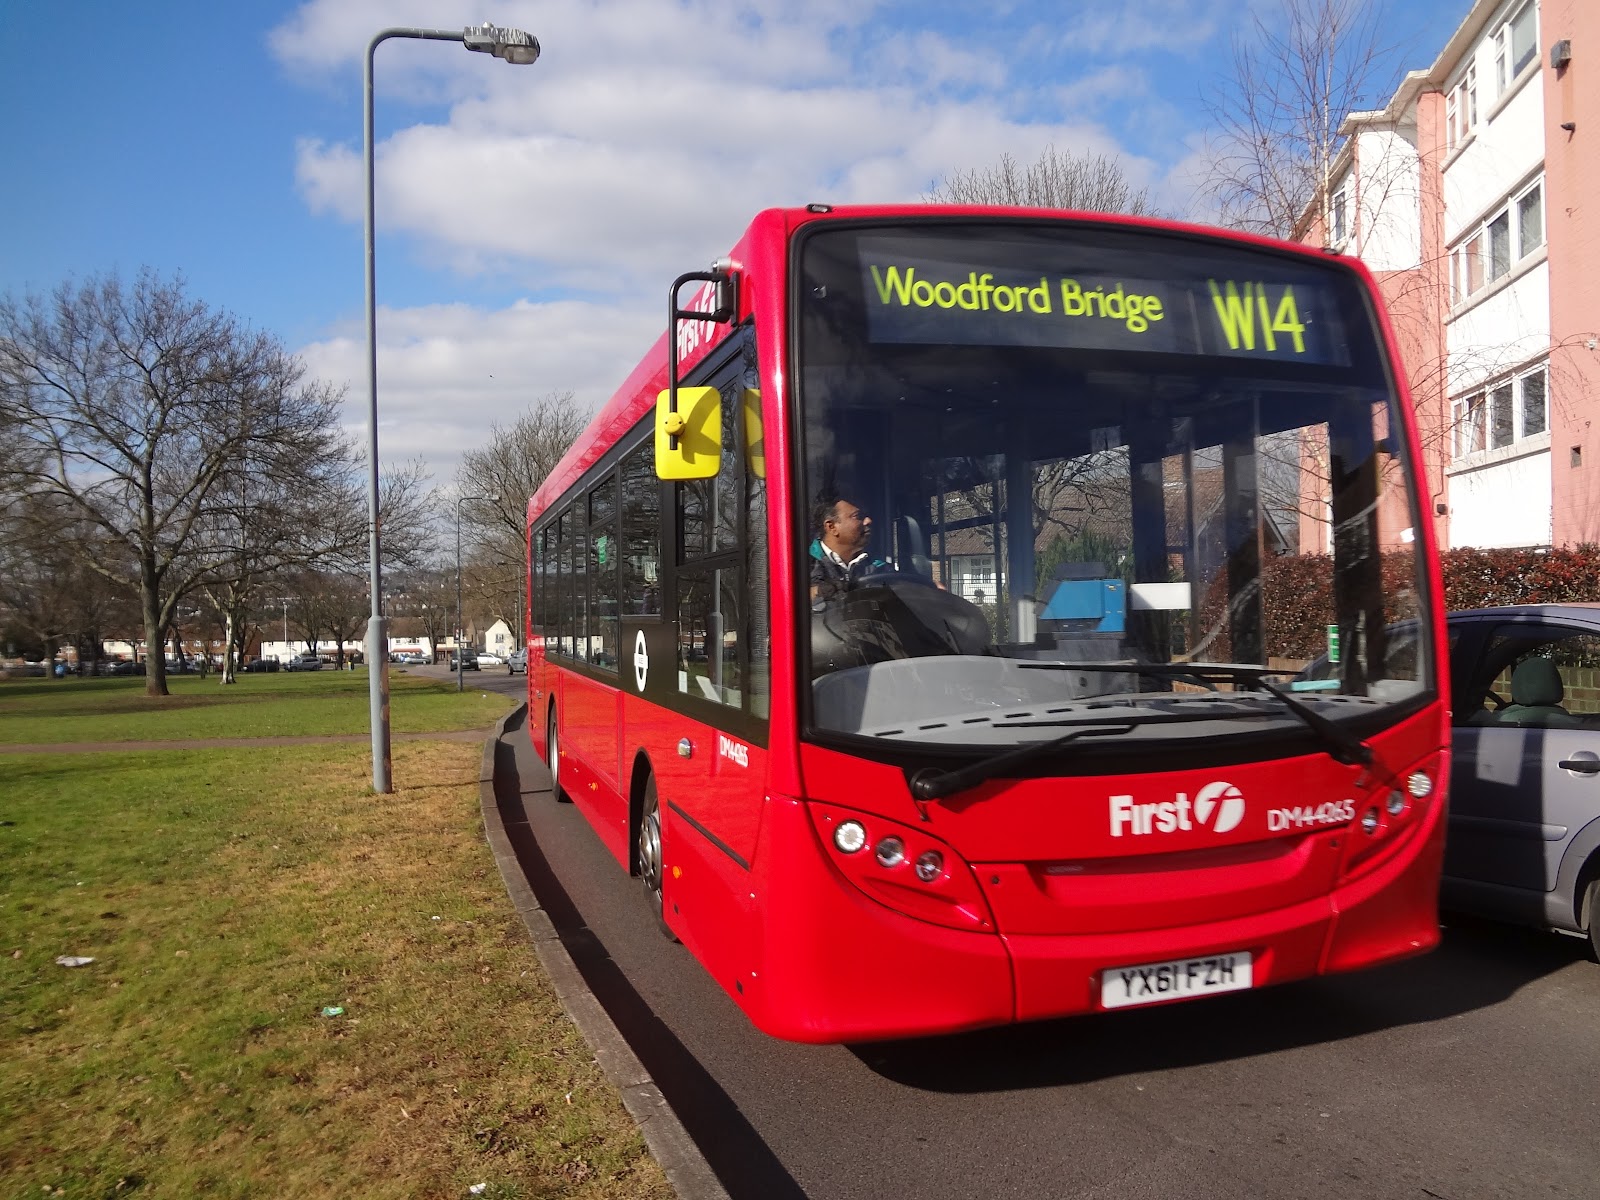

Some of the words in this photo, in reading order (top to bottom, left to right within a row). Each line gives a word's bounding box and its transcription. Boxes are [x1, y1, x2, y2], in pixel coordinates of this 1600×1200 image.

[871, 265, 1051, 315] Woodford
[1061, 278, 1164, 333] Bridge
[1207, 278, 1306, 353] W14
[1108, 792, 1193, 837] First
[1266, 798, 1356, 832] DM44265
[1120, 964, 1179, 998] YX61
[1186, 956, 1236, 989] FZH
